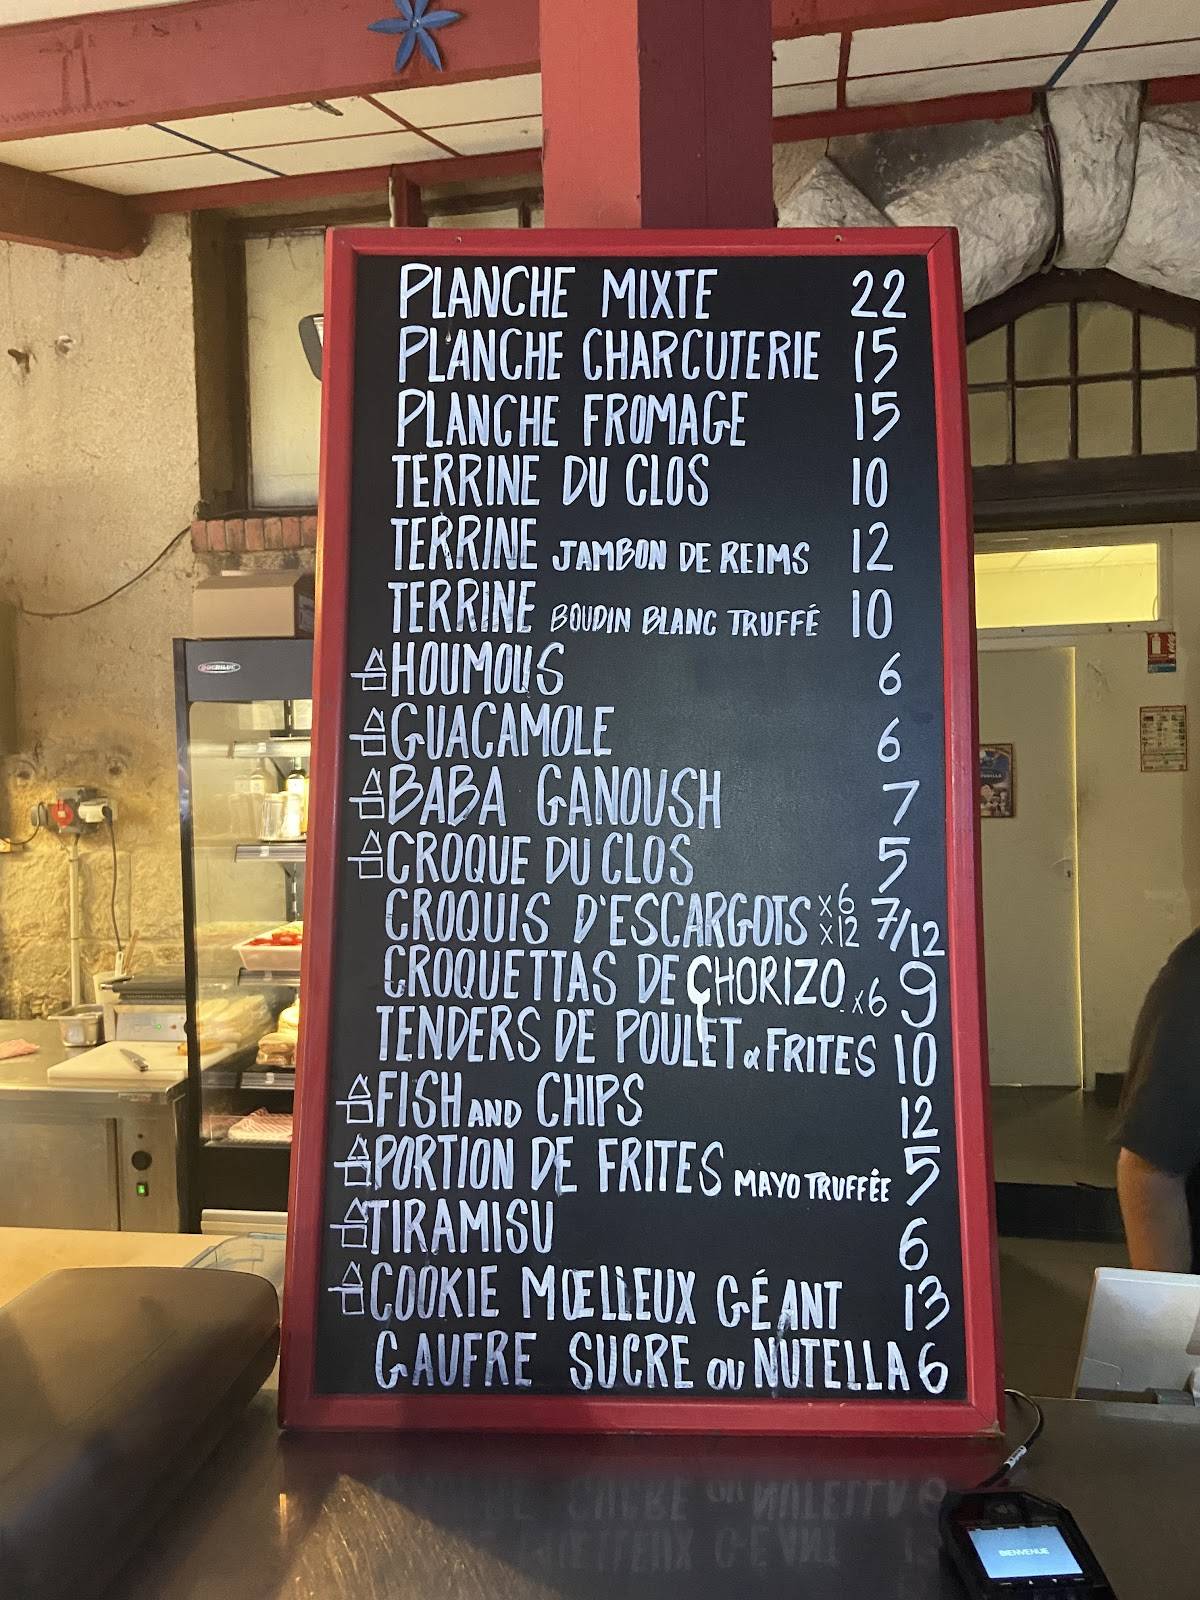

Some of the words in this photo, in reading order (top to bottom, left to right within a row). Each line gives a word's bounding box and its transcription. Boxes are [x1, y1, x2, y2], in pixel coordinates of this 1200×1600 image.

[399, 262, 576, 320] PLANCHE
[601, 267, 718, 320] MIXTE
[850, 268, 907, 319] 22
[398, 325, 564, 384] PLANCHE
[582, 327, 821, 382] CHARCUTERIE
[854, 326, 898, 384] 15
[396, 388, 559, 449] PLANCHE
[583, 390, 748, 447] FROMAGE
[854, 391, 901, 442] 15
[391, 452, 540, 509] TERRINE
[562, 454, 608, 508] DU
[625, 453, 709, 507] CLOS
[852, 457, 888, 508] 10
[390, 513, 538, 571] TERRINE
[552, 537, 667, 572] JAMBON
[679, 541, 712, 574] DE
[719, 540, 810, 576] REIMS
[852, 521, 894, 574] 12
[387, 577, 537, 634] TERRINE
[550, 602, 631, 634] BOUDIN
[641, 605, 717, 636] BLANC
[726, 603, 821, 637] TRUFFÉ
[852, 588, 893, 640] 10
[391, 640, 565, 698] HOUMOUS
[878, 651, 902, 696] 6
[391, 701, 615, 762] GUACAMOLE
[876, 716, 901, 763] 6
[388, 763, 507, 827] BABA
[537, 763, 722, 830] GANOUSH
[882, 779, 920, 827] 7
[386, 830, 532, 885] CROQUE
[545, 835, 591, 886] DU
[601, 831, 694, 887] CLOS
[878, 836, 911, 894] 5
[385, 887, 551, 945] CROQUIS
[573, 890, 812, 949] D'ESCARGOTS
[384, 944, 617, 1003] CROQUETTAS
[636, 953, 680, 1004] DE
[899, 960, 937, 1029] 9
[375, 1004, 541, 1063] TENDERS
[555, 1008, 596, 1064] DE
[615, 1003, 743, 1070] POULET
[766, 1027, 877, 1078] FRITES
[894, 1031, 937, 1087] 10
[376, 1069, 462, 1129] FISH
[467, 1098, 523, 1129] AND
[536, 1071, 644, 1128] CHIPS
[900, 1094, 939, 1140] 12
[374, 1133, 514, 1192] PORTION
[531, 1135, 578, 1196] DE
[598, 1136, 724, 1197] FRITES
[734, 1169, 801, 1200] MAYO
[803, 1167, 892, 1203] TRUFFÉE
[903, 1145, 941, 1207] 5
[363, 1198, 554, 1256] TIRAMISU
[898, 1217, 929, 1271] 6
[370, 1261, 500, 1321] COOKIE
[716, 1268, 843, 1333] GÉANT
[905, 1275, 950, 1332] 13
[375, 1329, 537, 1389] GAUFRE
[568, 1331, 694, 1390] SUCRE
[753, 1336, 910, 1391] NUTELLA
[918, 1341, 949, 1394] 6
[998, 1547, 1050, 1557] BIENVENUE
